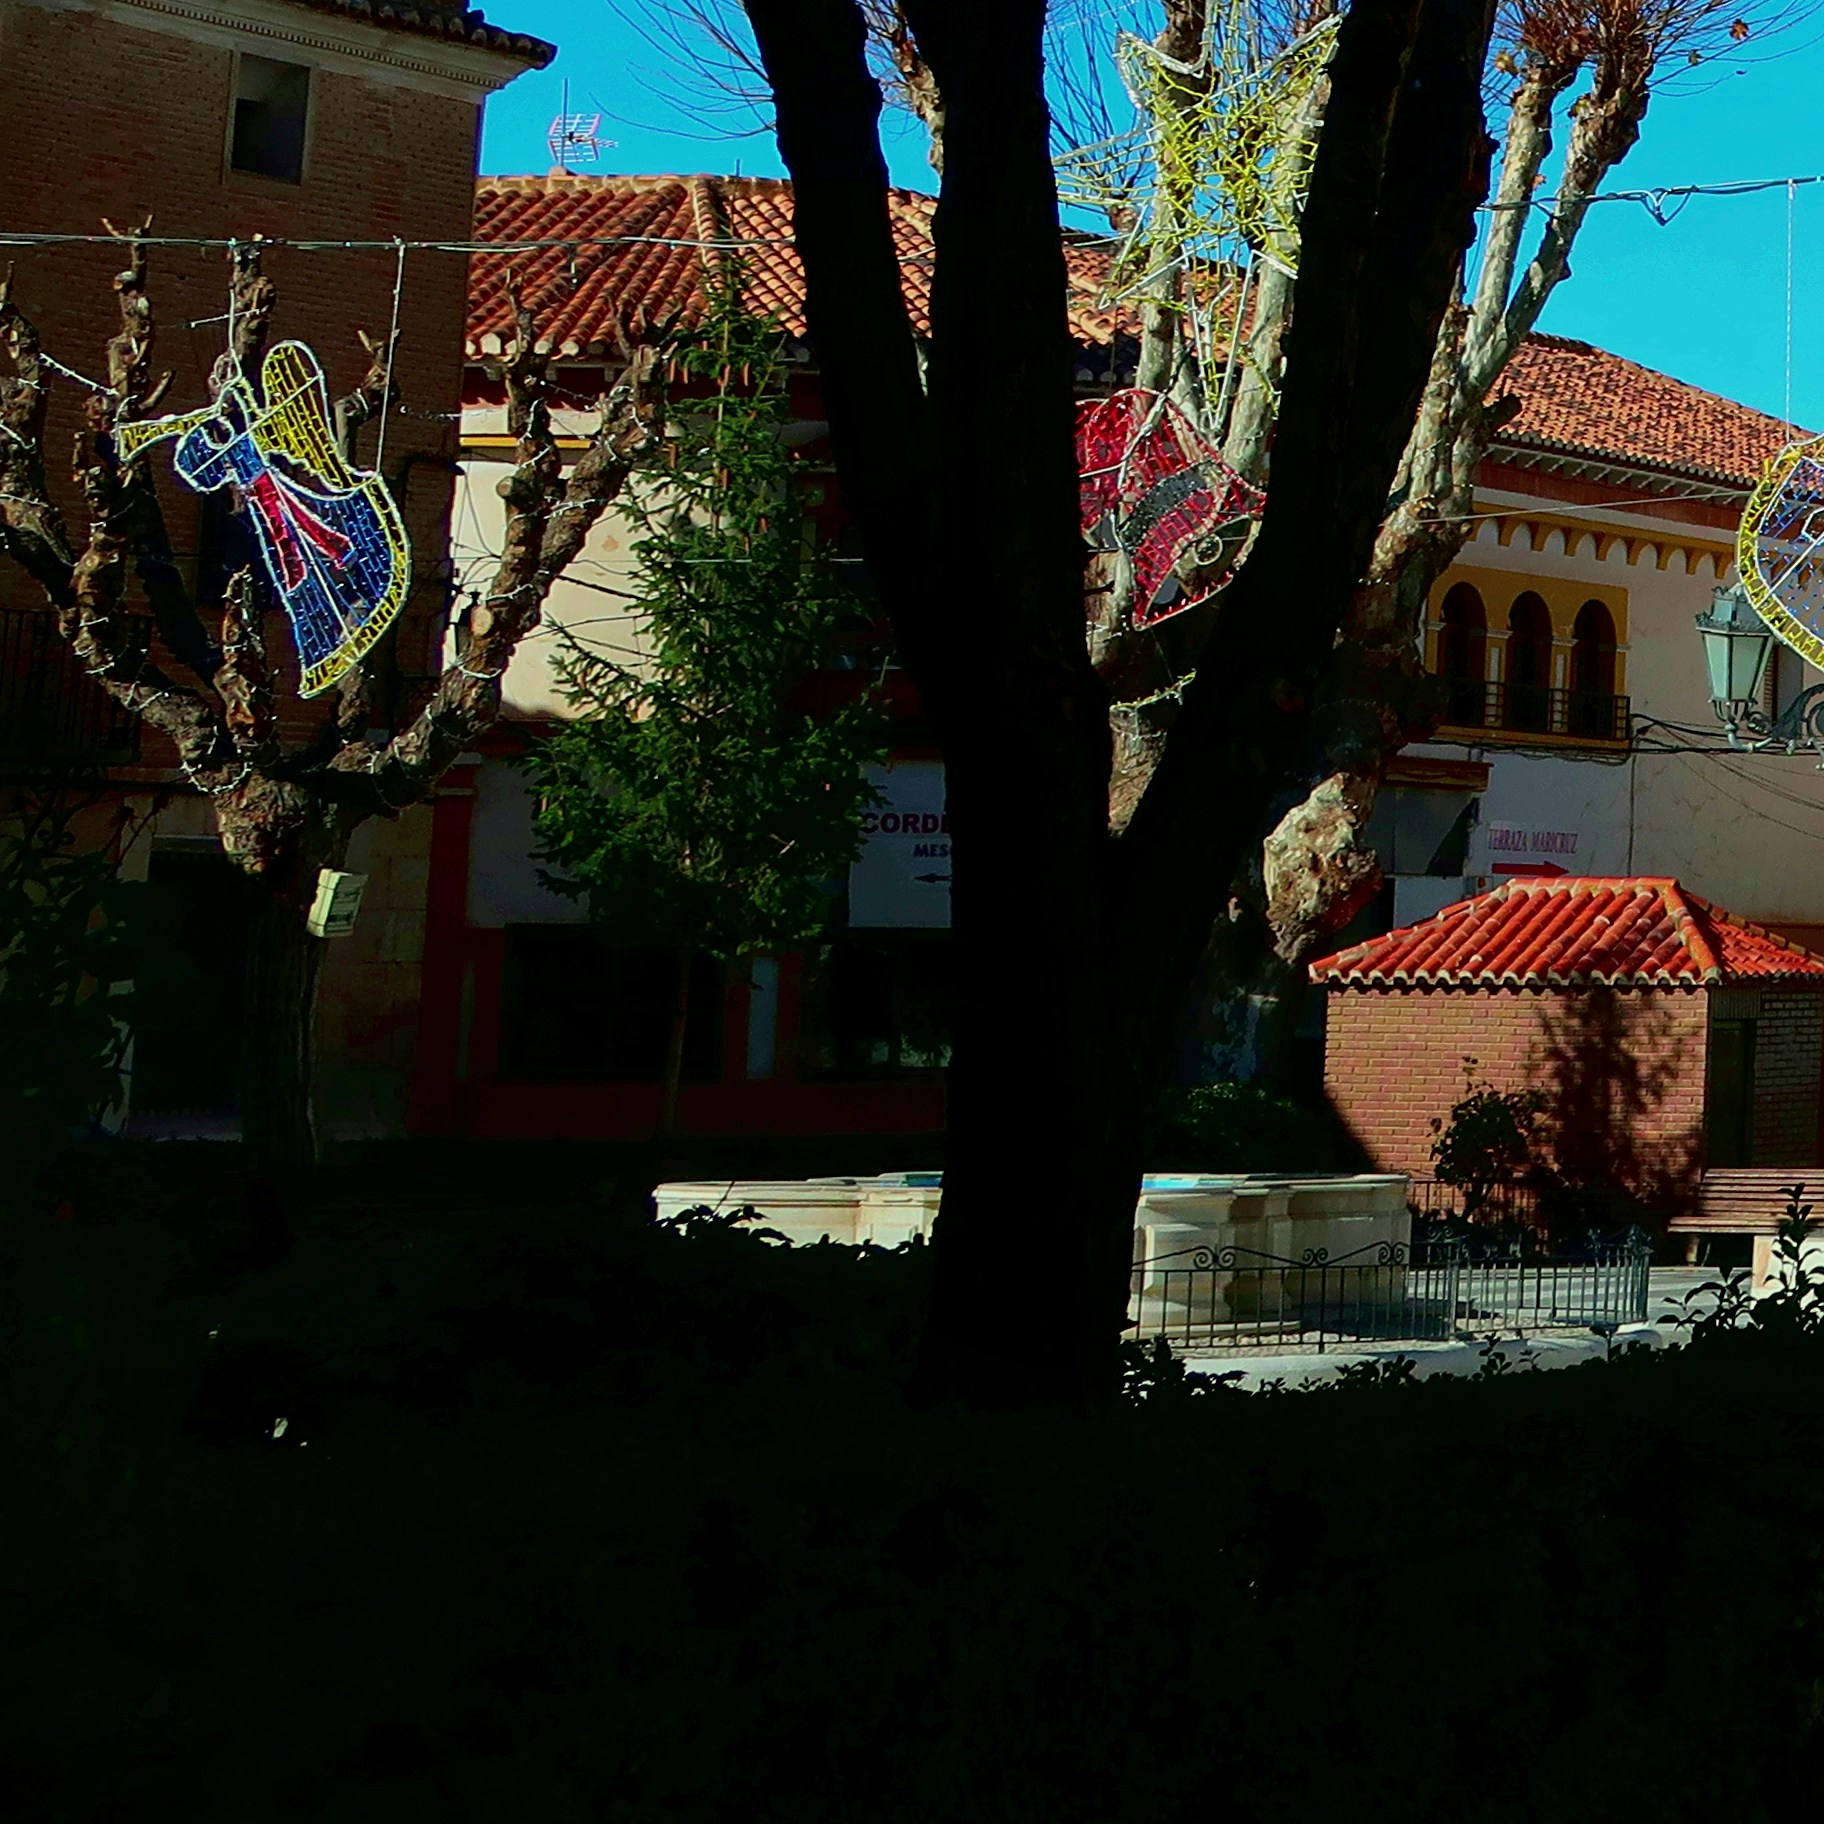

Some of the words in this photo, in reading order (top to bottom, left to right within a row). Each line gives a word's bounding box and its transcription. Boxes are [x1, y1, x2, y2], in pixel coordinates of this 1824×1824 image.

[913, 843, 953, 858] MES
[1488, 828, 1527, 852] TERRAZA
[1530, 830, 1579, 854] MARICRUZ
